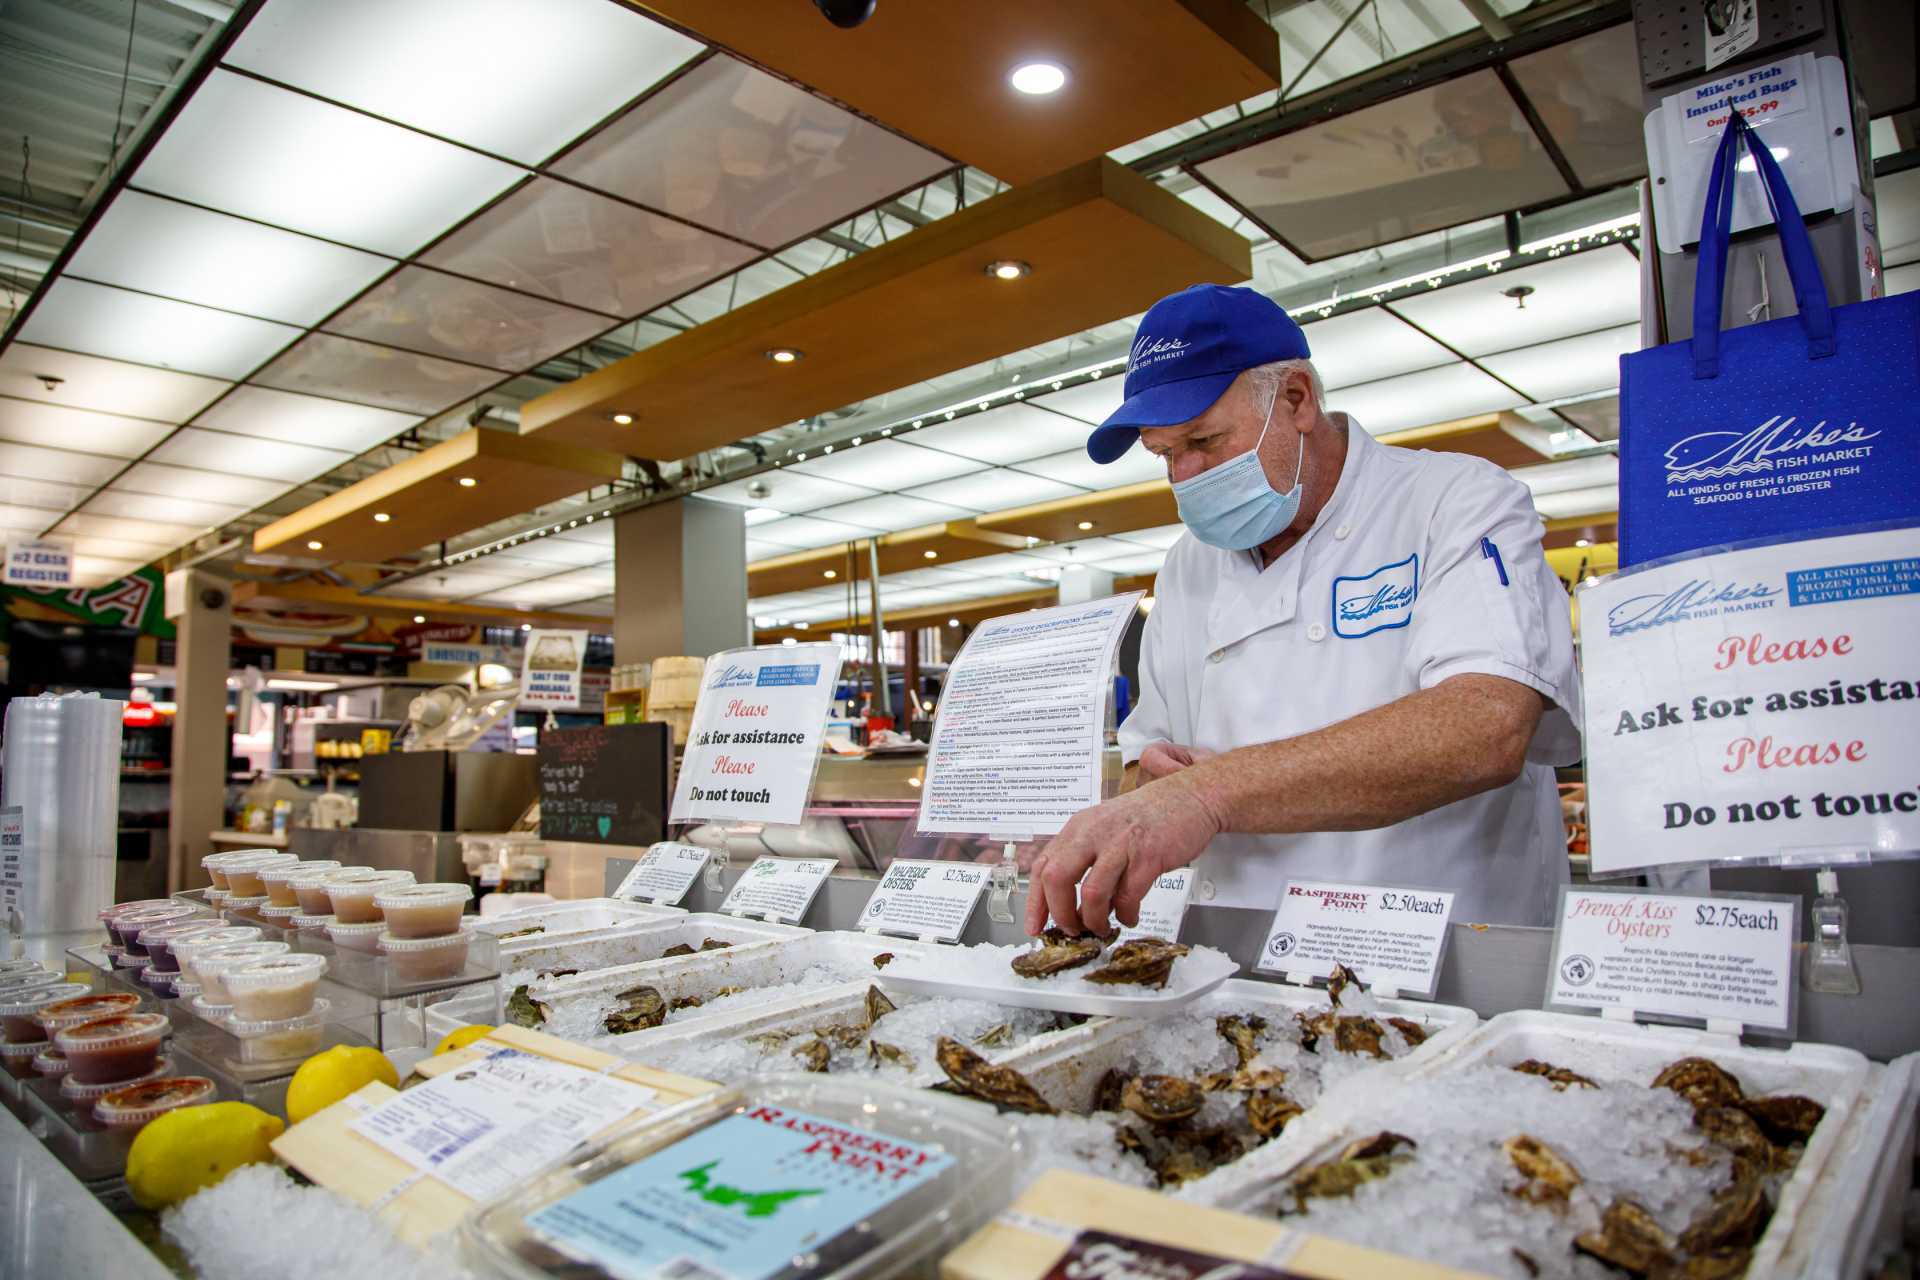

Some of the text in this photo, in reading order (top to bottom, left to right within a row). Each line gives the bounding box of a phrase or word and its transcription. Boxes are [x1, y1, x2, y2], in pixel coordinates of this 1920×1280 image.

[1696, 67, 1782, 100] Mike's Fish
[1760, 78, 1798, 97] Bags
[1707, 116, 1730, 128] Onl
[1153, 350, 1185, 361] MARKET
[1727, 415, 1882, 466] Mike's
[1776, 446, 1874, 469] FISH MARKET
[1667, 487, 1686, 498] ALL
[1688, 483, 1721, 496] KINDS
[1723, 481, 1737, 492] OF
[1740, 477, 1775, 489] FRESH
[1786, 470, 1832, 484] FROZEN
[1833, 465, 1861, 477] FISH
[1693, 480, 1832, 505] SEAFOOD & LIVE LOBSTER
[1796, 560, 1920, 584] ALL KINDS OF FRE
[1797, 578, 1853, 593] FROZEN
[1895, 570, 1920, 581] SEA
[1655, 580, 1783, 619] Mike's
[1812, 590, 1845, 601] LIVE
[1847, 583, 1911, 600] LOBSTER
[1693, 599, 1776, 620] FISH MARKET
[1713, 633, 1854, 671] Please
[725, 699, 769, 718] Please
[1614, 702, 1684, 736] Ask
[1691, 695, 1754, 722] for
[711, 730, 731, 745] for
[732, 729, 805, 745] assistance
[711, 755, 755, 774] Please
[1722, 735, 1868, 774] Please
[689, 786, 770, 804] Do not touch
[1663, 801, 1716, 829] Do
[1727, 795, 1801, 824] not
[882, 877, 917, 891] OYSTERS
[1288, 886, 1444, 915] RASPBERRY $2.50each
[1322, 898, 1368, 911] POINT
[1568, 896, 1779, 931] French Kiss $2.75each
[1606, 917, 1672, 943] Oysters
[747, 1107, 940, 1167] RASPBERRY
[802, 1140, 918, 1181] POINT
